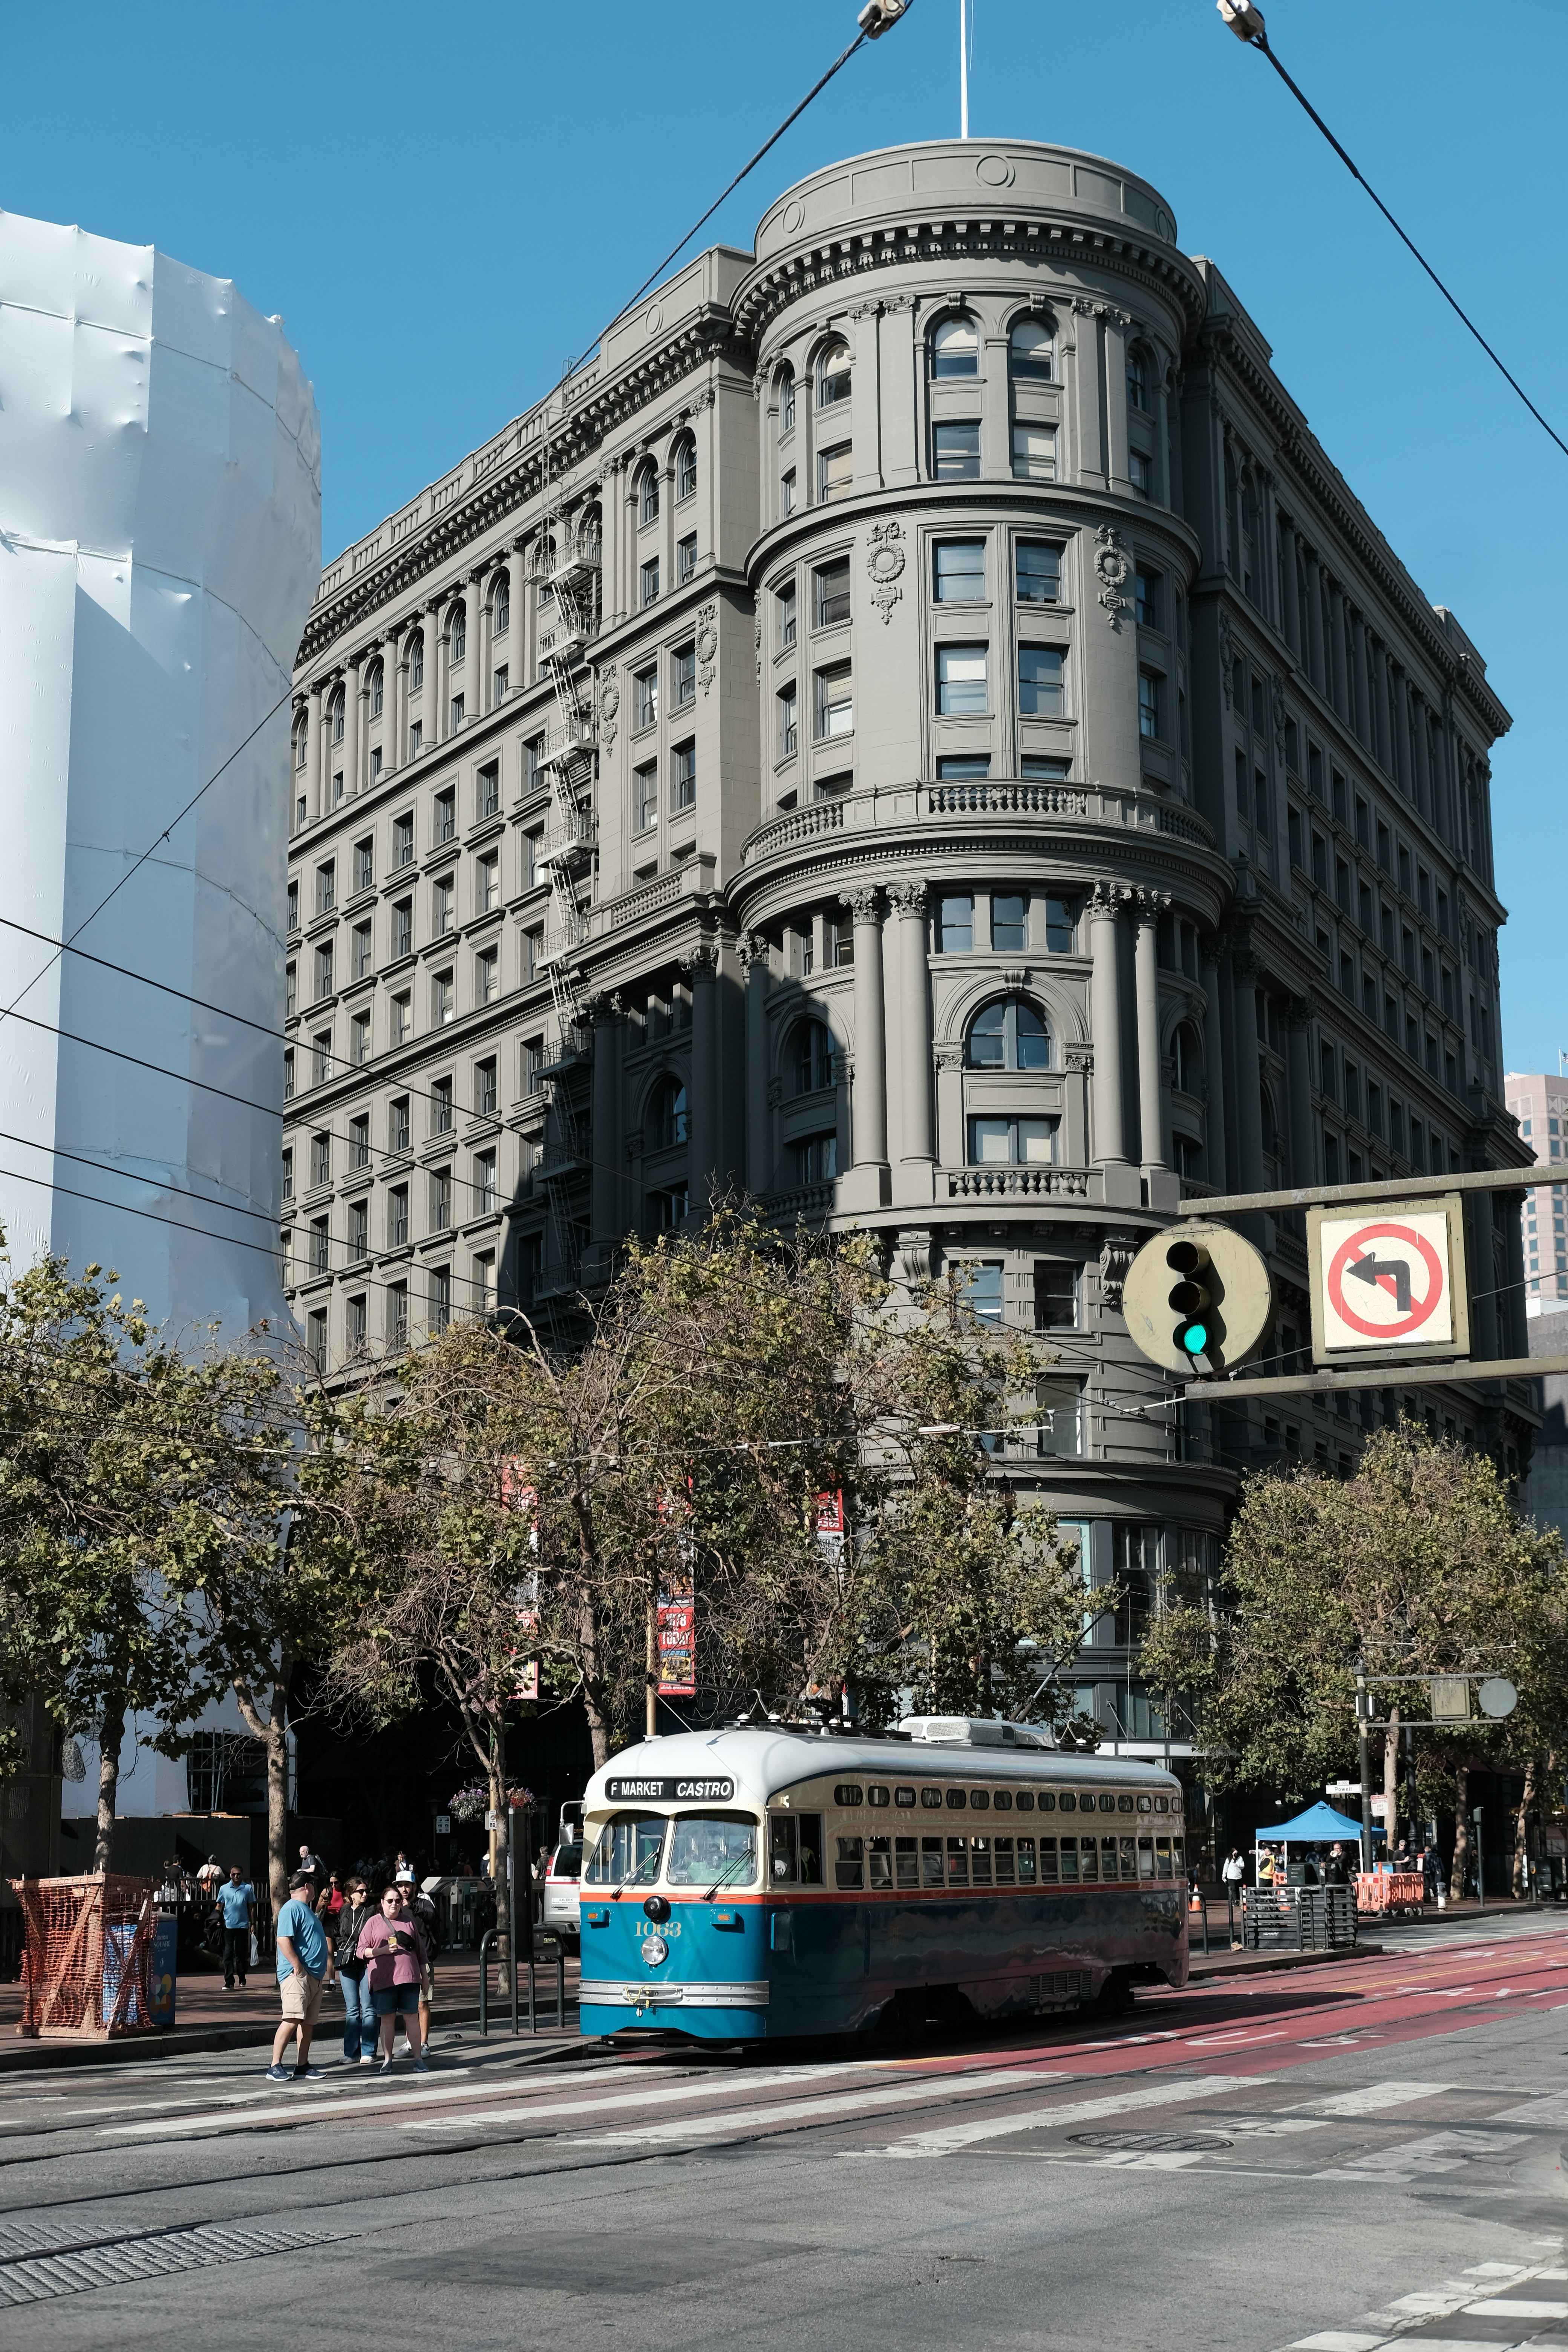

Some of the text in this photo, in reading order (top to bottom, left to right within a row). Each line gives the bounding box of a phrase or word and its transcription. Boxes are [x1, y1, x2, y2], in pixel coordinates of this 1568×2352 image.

[662, 1631, 691, 1645] TODAY
[611, 1781, 730, 1796] F MARKET CASTRO
[634, 1921, 681, 1937] 1063
